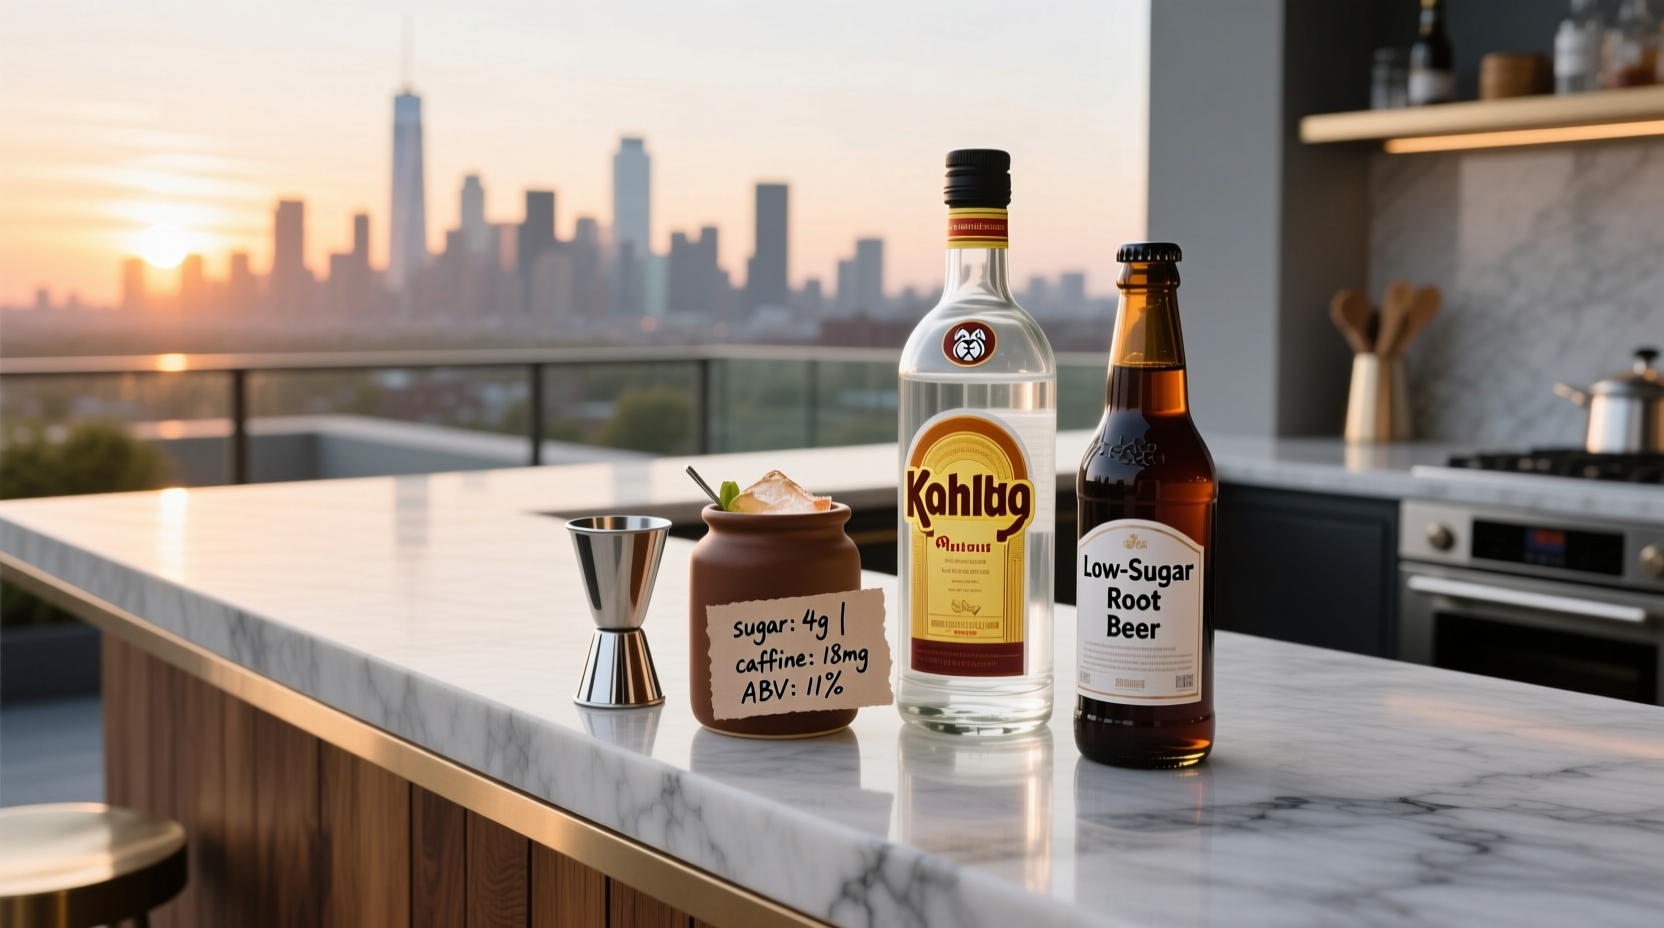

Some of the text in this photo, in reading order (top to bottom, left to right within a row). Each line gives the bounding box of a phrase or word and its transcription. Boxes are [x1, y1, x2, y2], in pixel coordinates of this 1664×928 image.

[1084, 554, 1194, 588] Low-Sugar
[1107, 586, 1161, 611] Root
[733, 618, 795, 646] sugar:
[802, 608, 829, 641] 4g
[1106, 614, 1161, 640] Beer
[735, 643, 869, 674] caffine: 18mg
[741, 670, 844, 704] ABV: 11%
